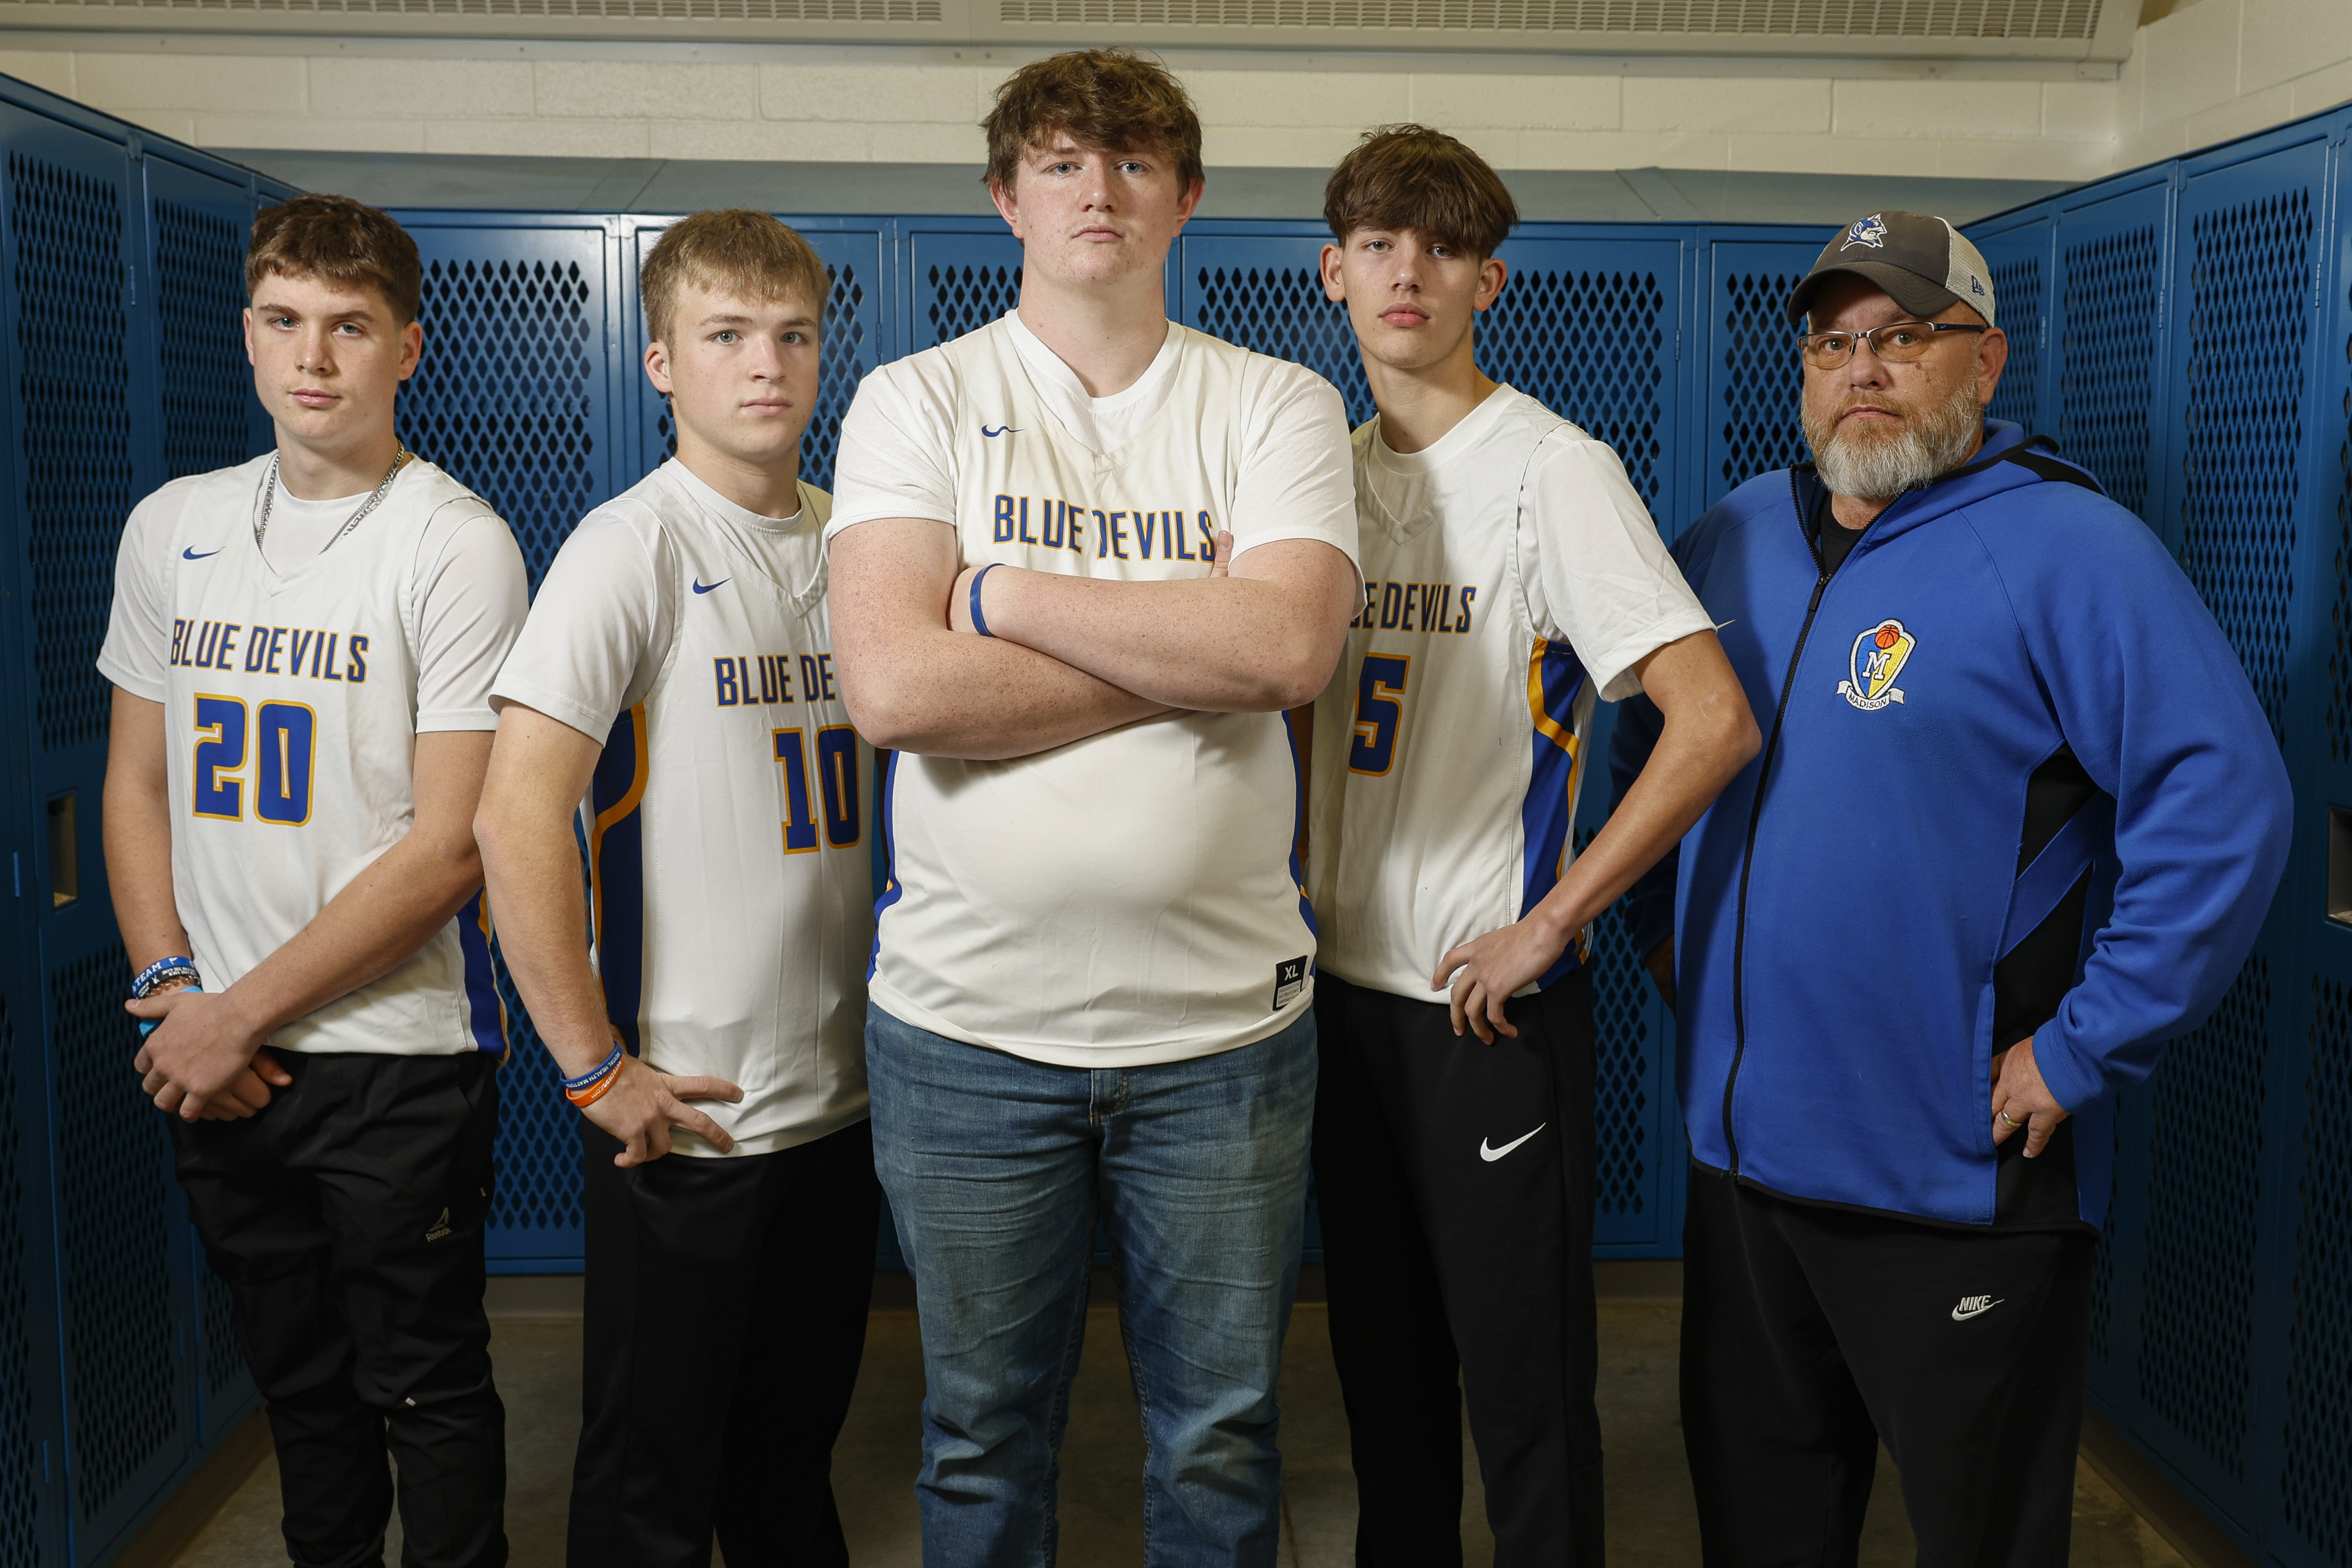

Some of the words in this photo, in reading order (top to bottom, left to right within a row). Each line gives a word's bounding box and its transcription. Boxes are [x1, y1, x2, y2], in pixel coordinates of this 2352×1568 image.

[993, 493, 1085, 555] BLUE
[1092, 509, 1214, 563] DEVILS
[1379, 581, 1477, 635] DEVILS
[170, 617, 243, 671] BLUE
[244, 625, 369, 684] DEVILS
[1861, 651, 1892, 681] M
[713, 655, 794, 707] BLUE
[799, 653, 836, 702] DE
[1848, 692, 1887, 709] MADISON
[1348, 652, 1411, 777] 5
[192, 692, 317, 828] 20
[771, 724, 861, 855] 10
[134, 962, 162, 986] TEAM
[1284, 965, 1299, 980] XL
[589, 1066, 609, 1081] HEALTH
[1959, 1295, 1991, 1311] NIKE
